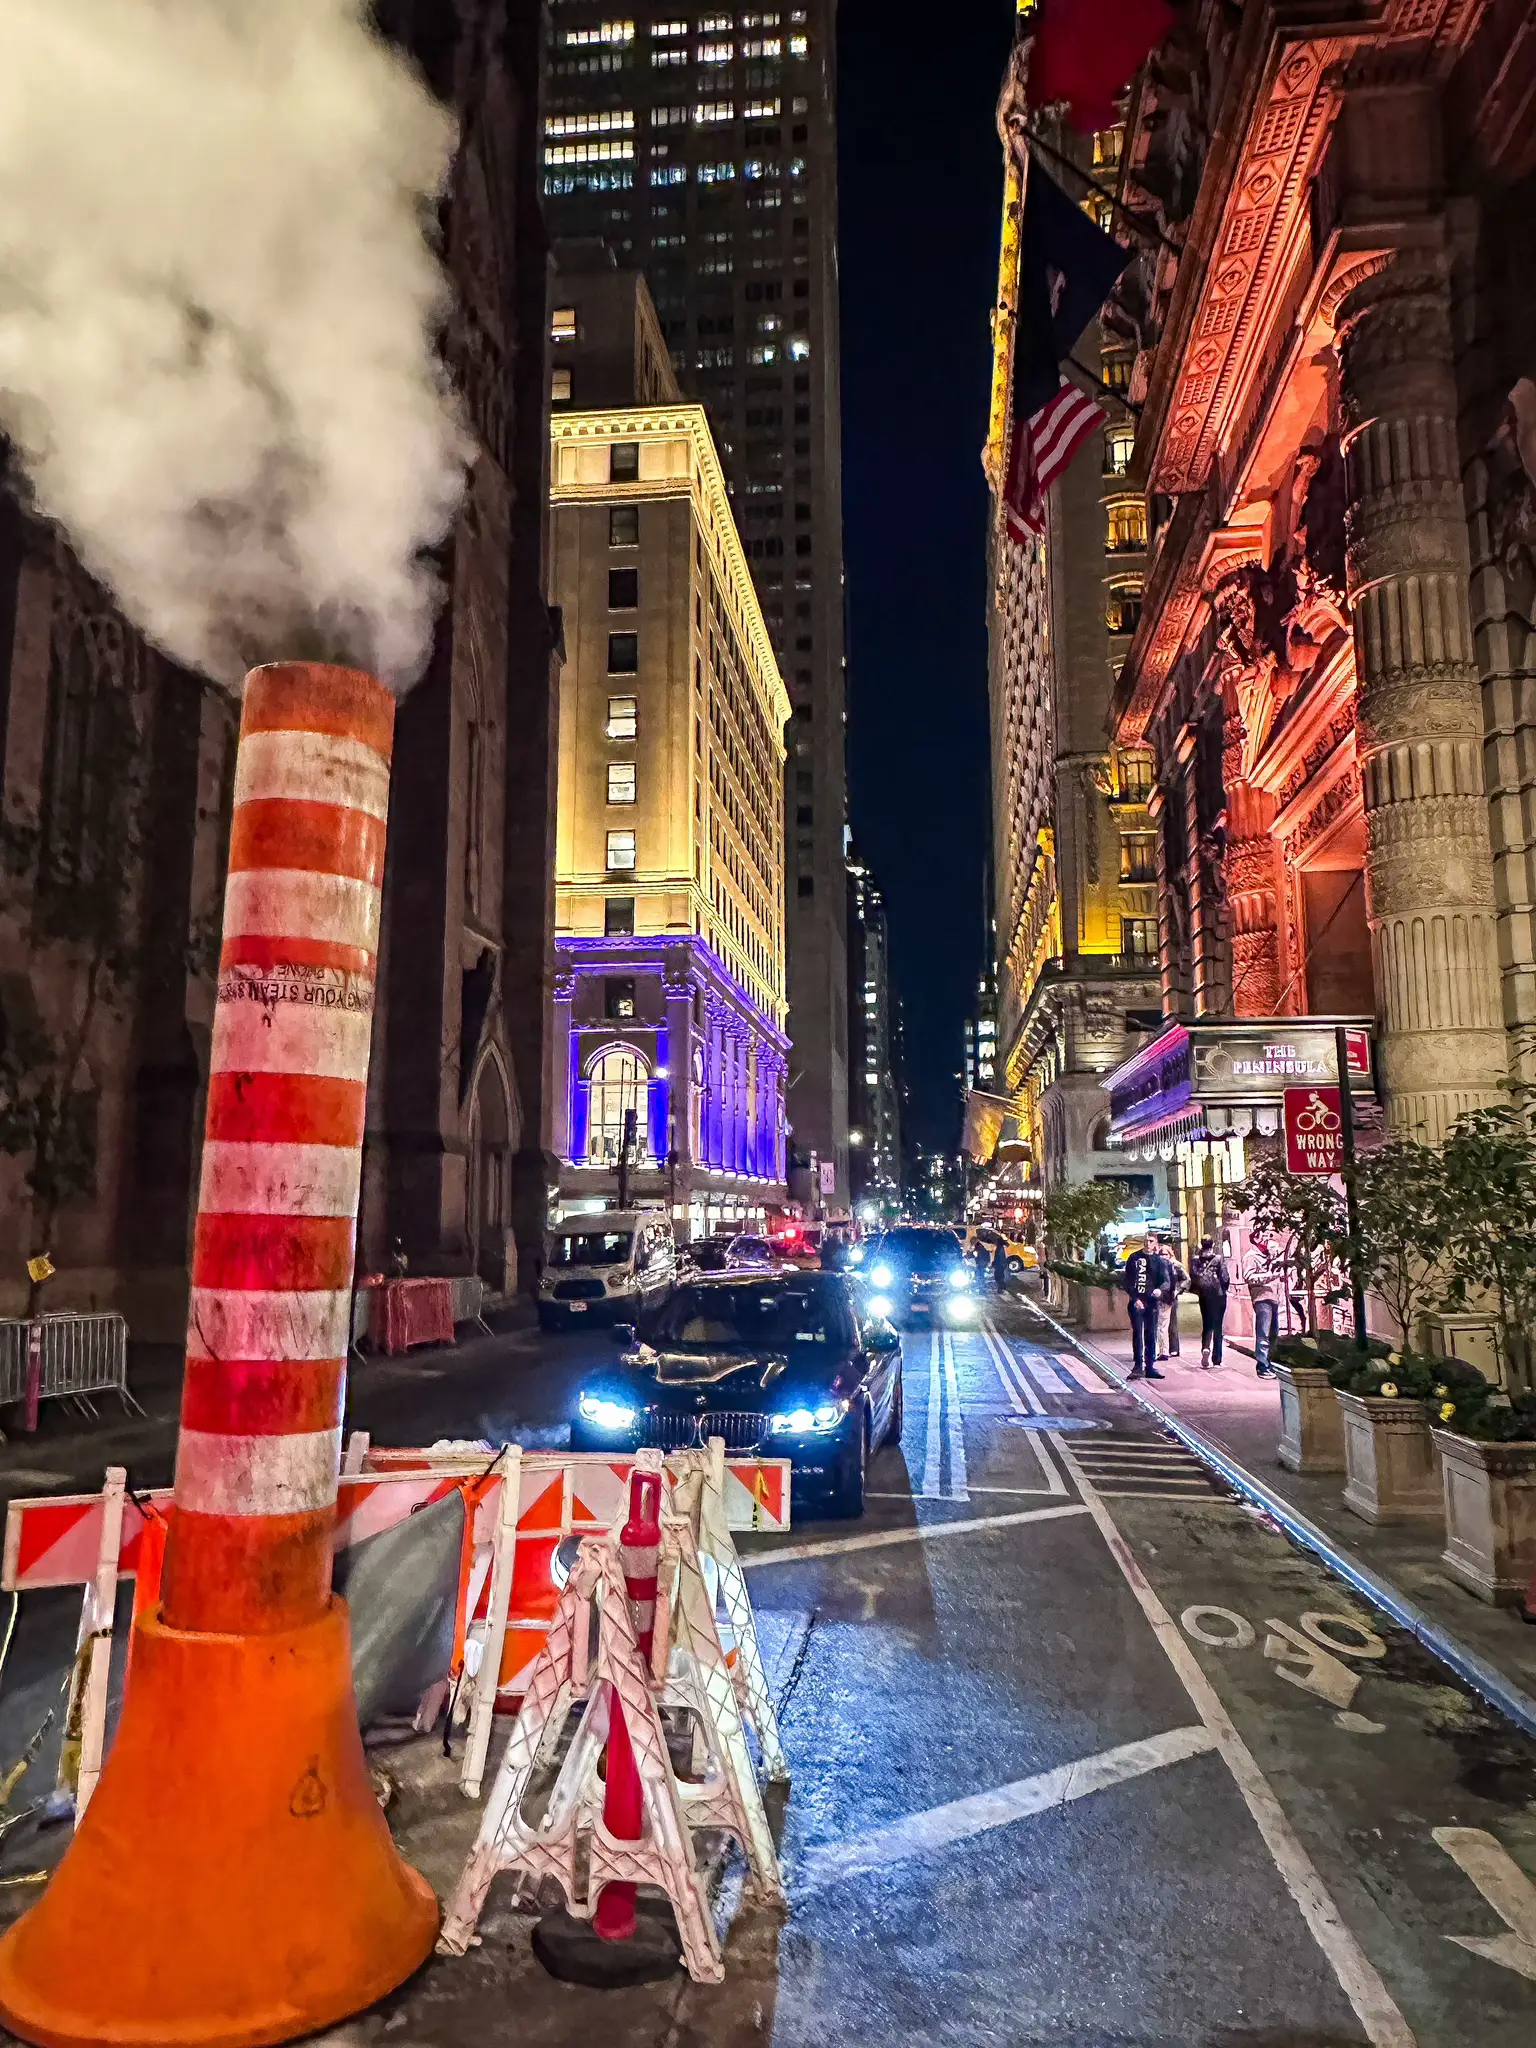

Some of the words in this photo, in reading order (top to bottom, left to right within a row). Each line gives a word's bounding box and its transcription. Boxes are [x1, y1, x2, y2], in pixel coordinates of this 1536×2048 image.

[303, 984, 344, 1008] YOUR
[1263, 1045, 1296, 1058] THE
[1233, 1060, 1327, 1074] PENINSULA
[1296, 1134, 1344, 1150] WRONG
[1307, 1152, 1335, 1168] WAY
